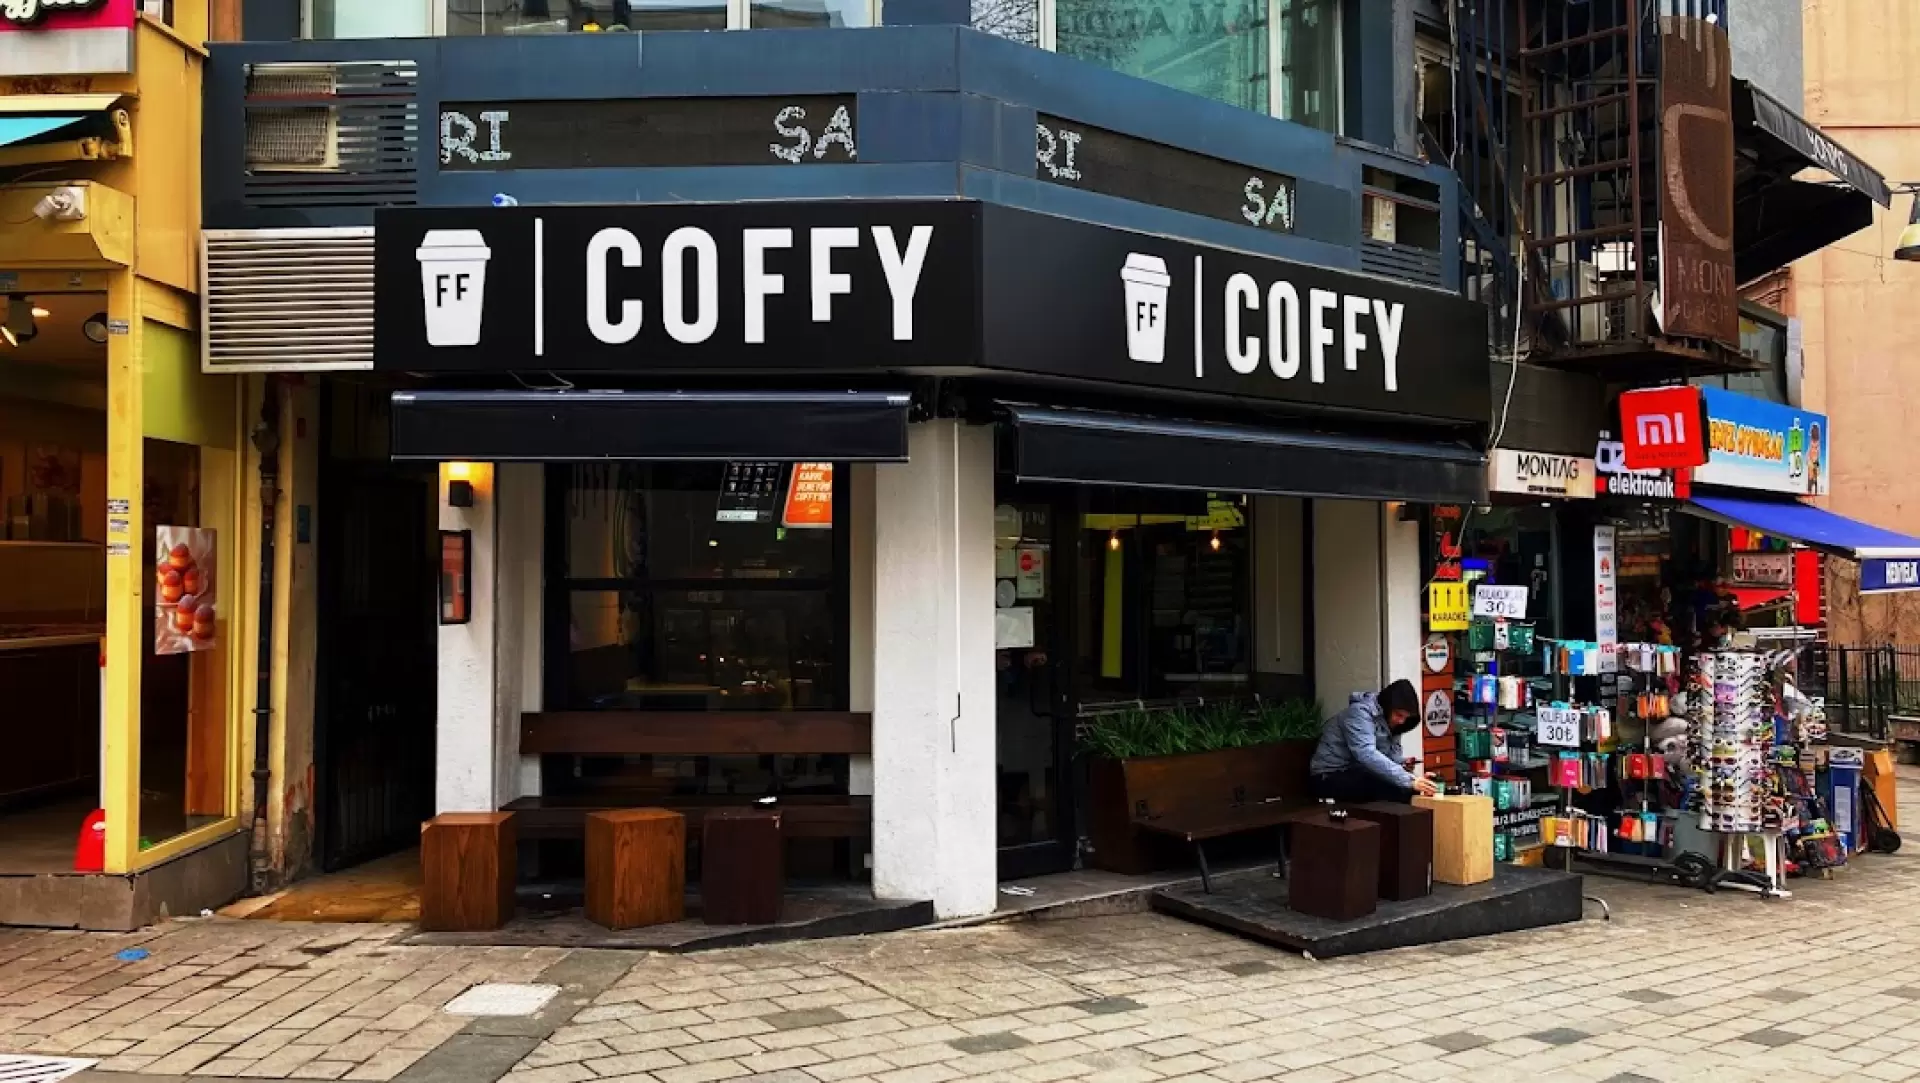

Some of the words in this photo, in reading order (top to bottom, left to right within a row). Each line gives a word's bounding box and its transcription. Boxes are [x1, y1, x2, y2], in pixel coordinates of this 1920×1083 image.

[436, 273, 470, 307] FF
[587, 226, 934, 343] COFFY
[1137, 301, 1158, 332] FF
[1225, 272, 1404, 391] COFFY
[1517, 453, 1579, 480] MONTAG
[1432, 612, 1466, 622] KARAOKE
